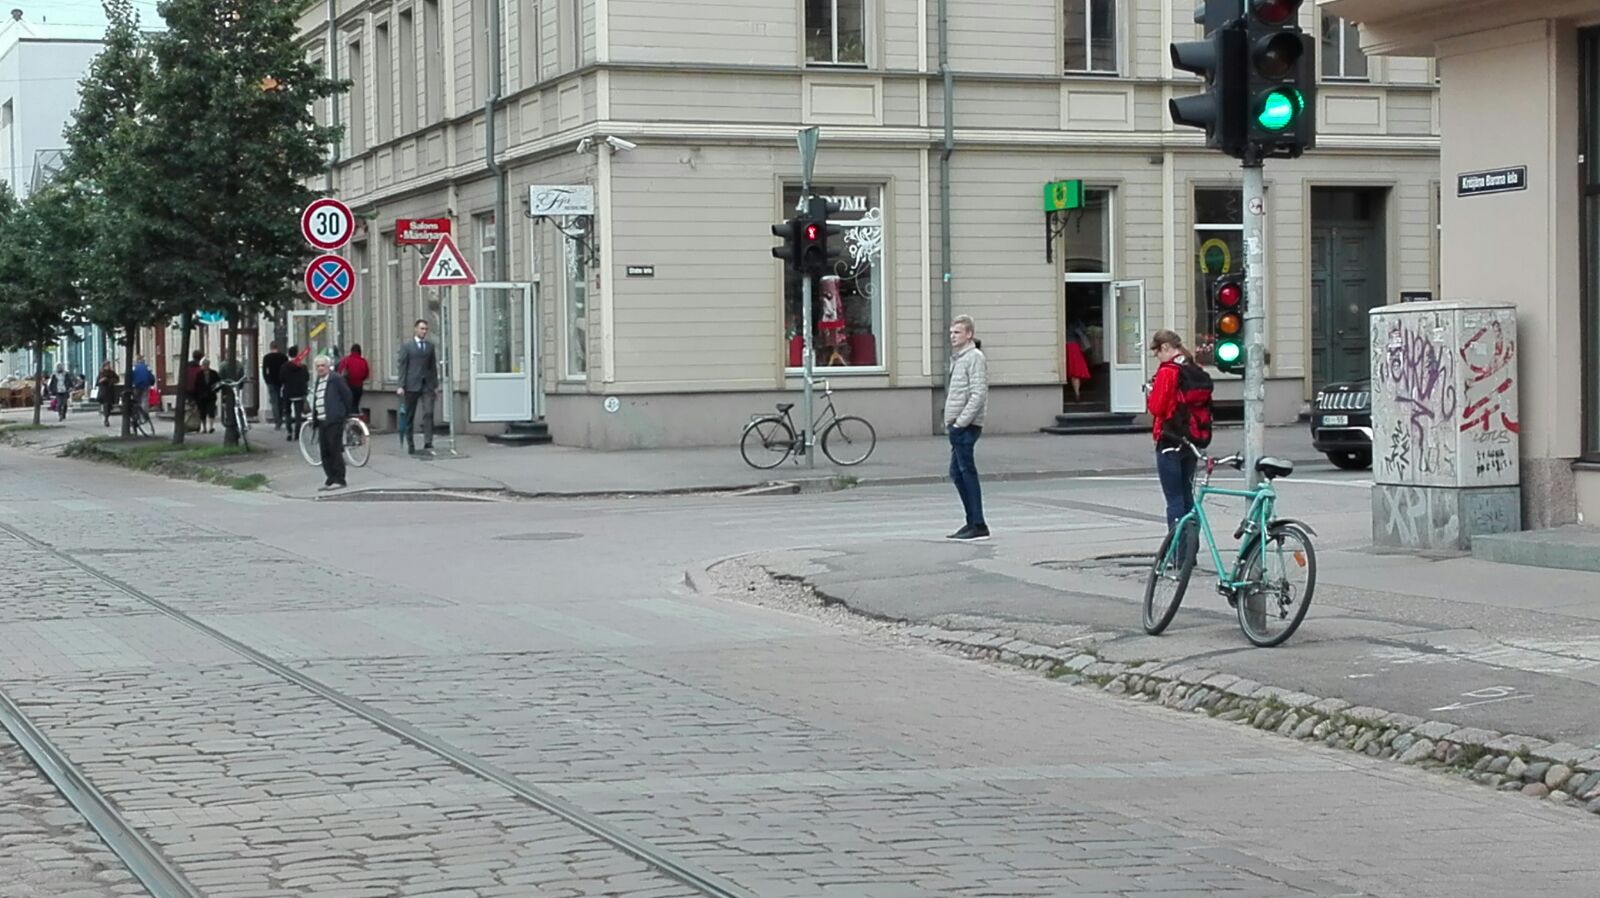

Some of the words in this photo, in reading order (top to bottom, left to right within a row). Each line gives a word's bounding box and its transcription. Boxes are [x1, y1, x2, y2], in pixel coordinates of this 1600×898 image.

[795, 195, 867, 211] AUMI
[316, 212, 340, 236] 30
[410, 221, 439, 230] Salons
